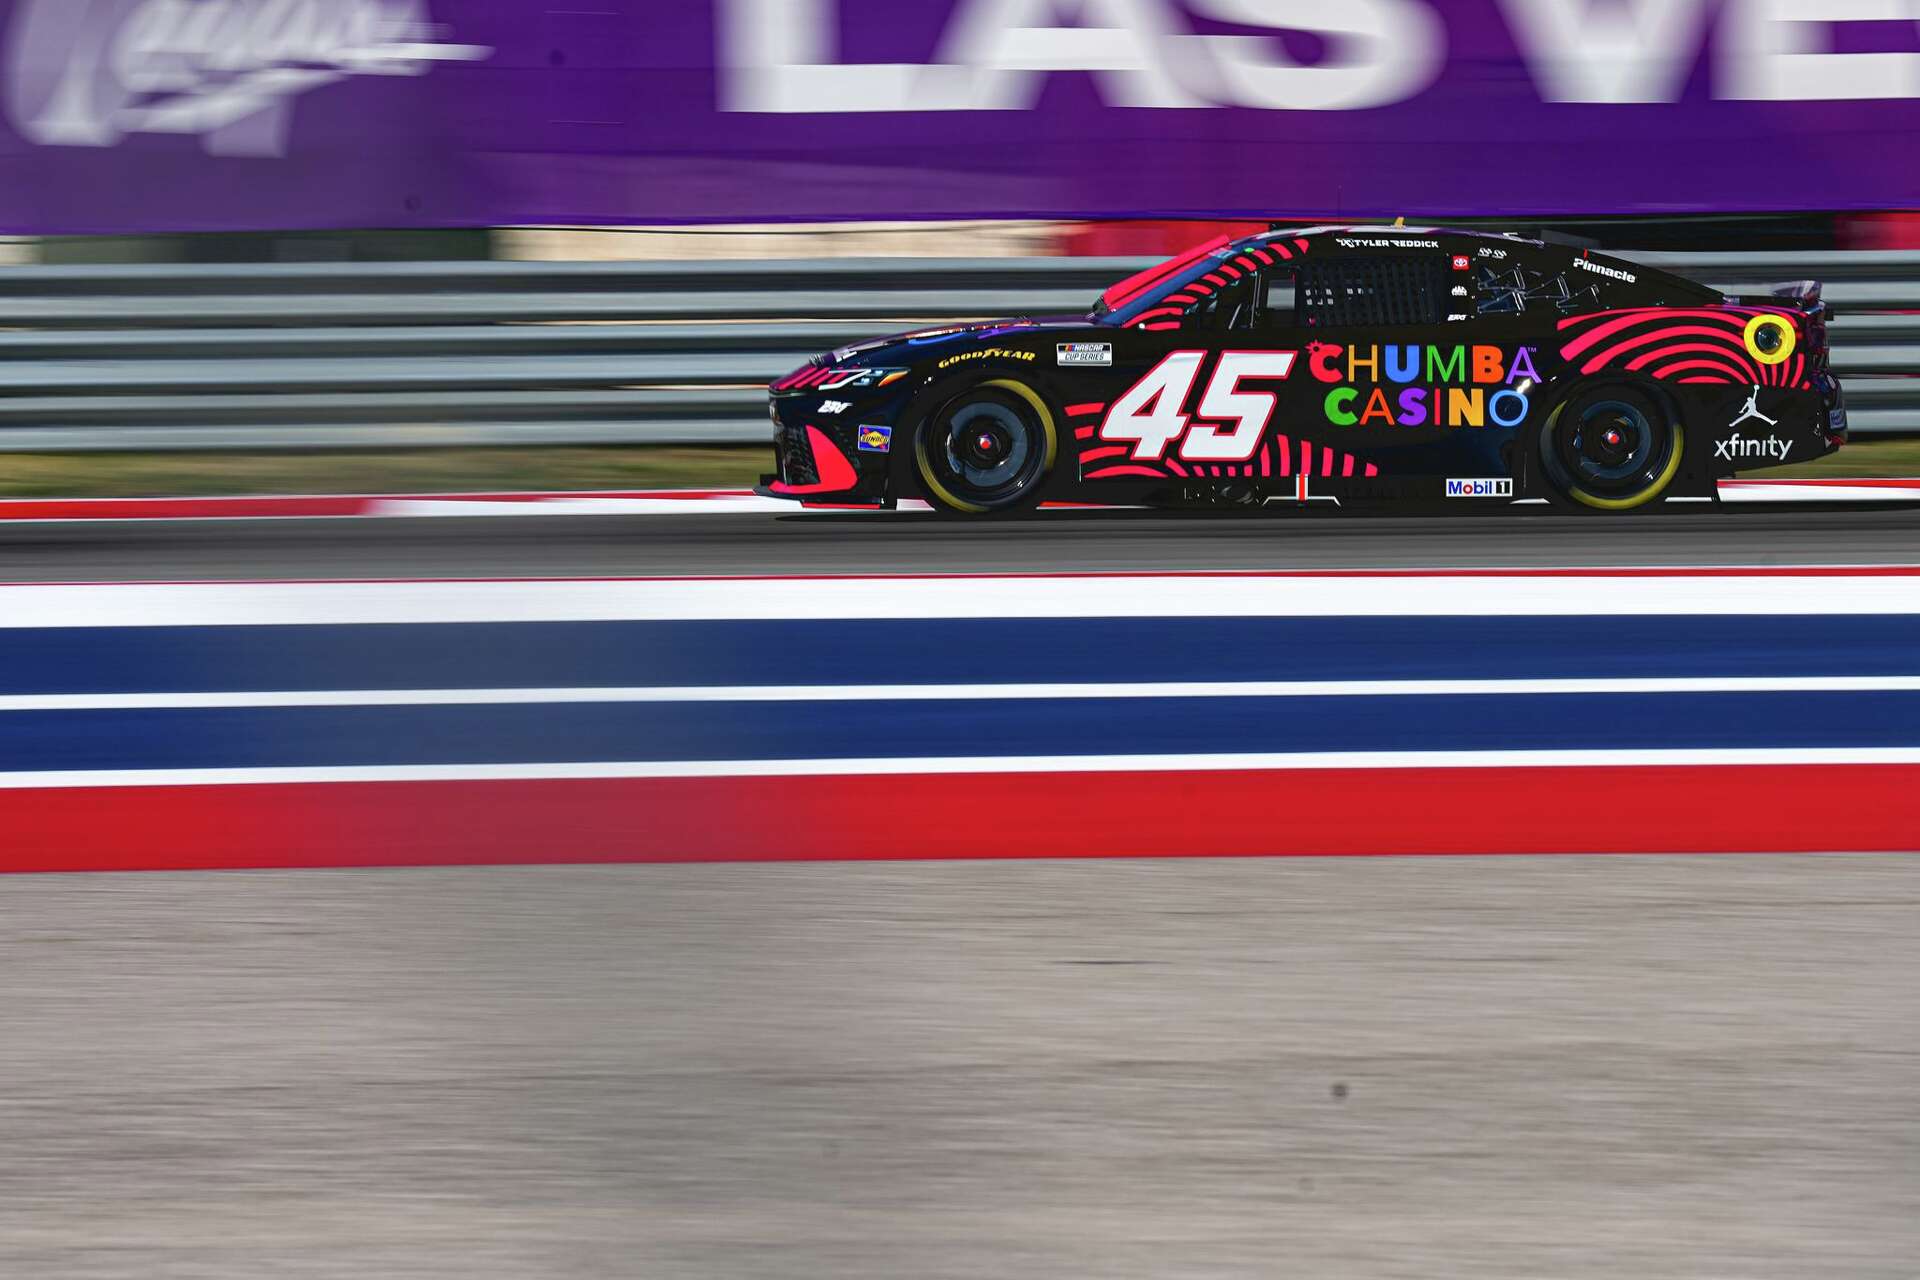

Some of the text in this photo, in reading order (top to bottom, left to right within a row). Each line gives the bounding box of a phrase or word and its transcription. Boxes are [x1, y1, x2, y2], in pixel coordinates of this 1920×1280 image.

[1354, 239, 1389, 248] TYLER
[1389, 240, 1439, 248] REDDICK
[1573, 256, 1636, 284] Pinnacle
[938, 347, 1036, 369] GOODYEAR
[1074, 344, 1104, 352] NASCAR
[1305, 340, 1543, 385] CHUMBA
[1099, 349, 1298, 461] 45
[1324, 386, 1529, 427] CASINO
[1713, 433, 1793, 461] xfinity
[1448, 481, 1493, 495] Mobil
